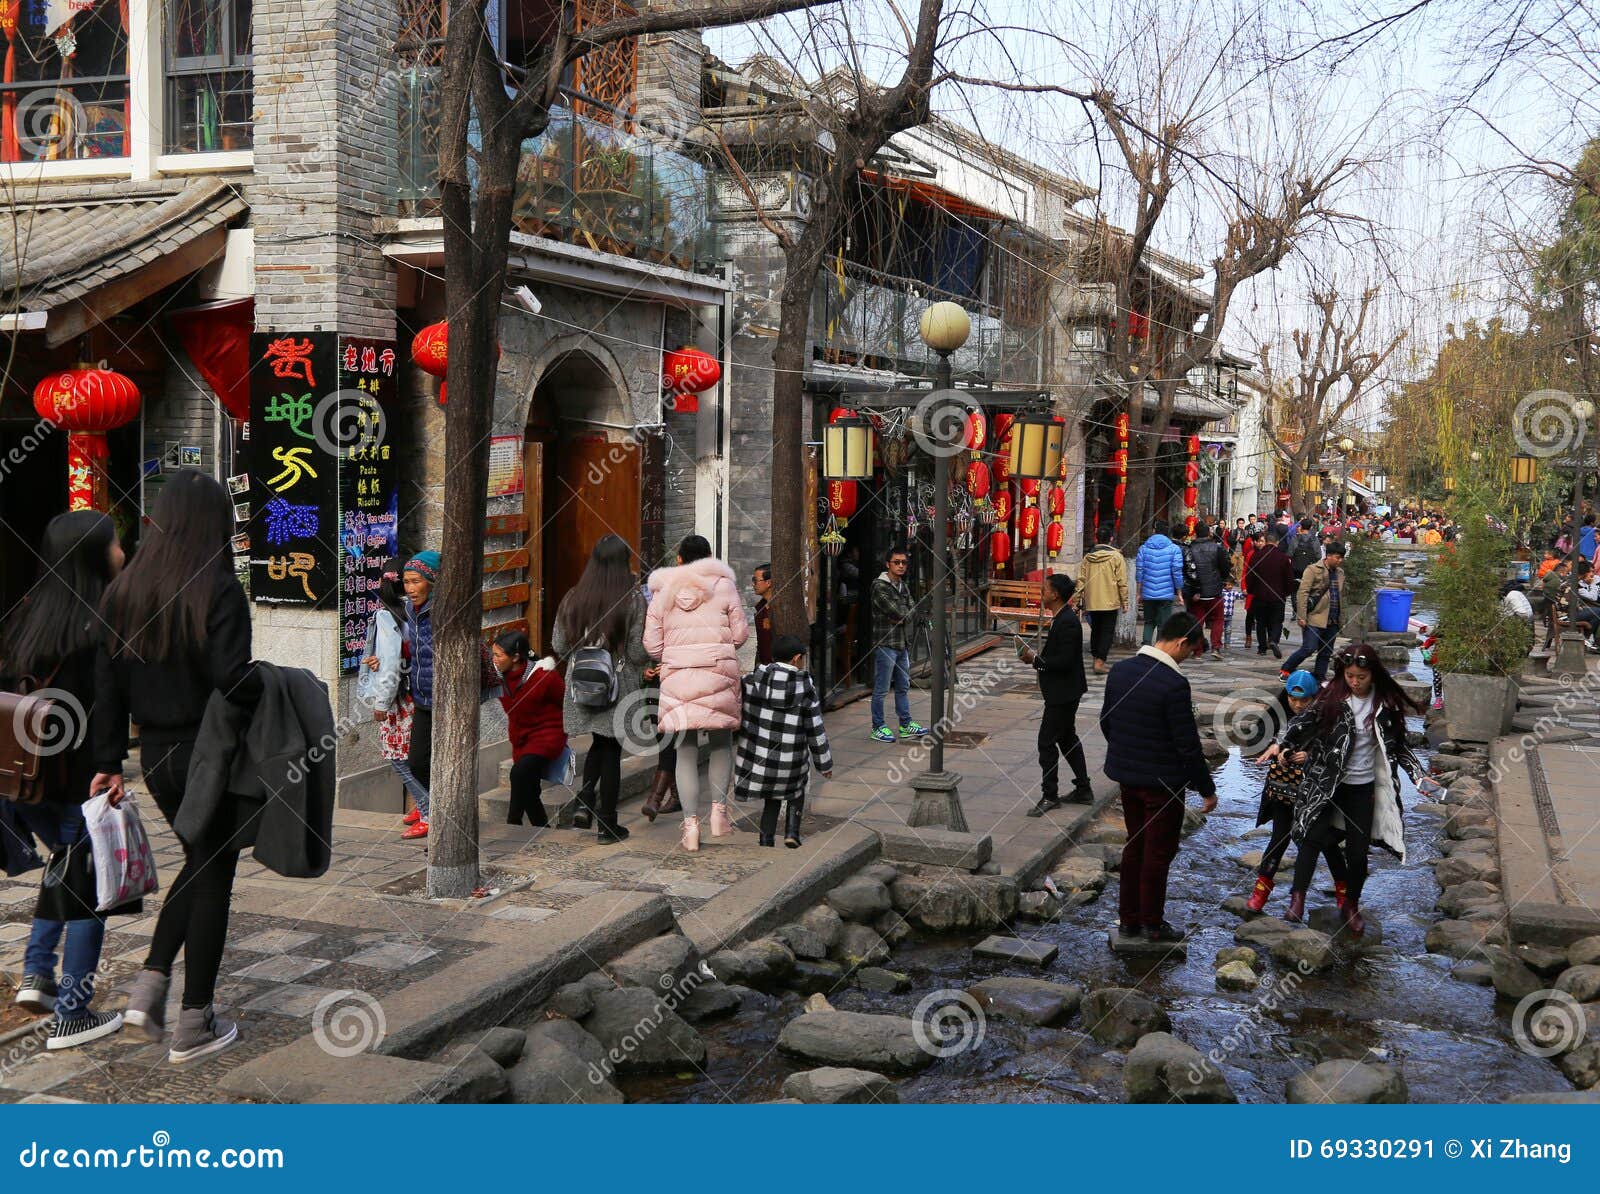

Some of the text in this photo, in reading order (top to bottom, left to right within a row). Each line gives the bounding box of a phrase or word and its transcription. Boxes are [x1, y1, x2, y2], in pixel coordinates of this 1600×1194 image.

[343, 344, 395, 377] 老地方
[357, 377, 380, 395] 牛排
[348, 444, 391, 461] 意大利面
[359, 465, 377, 475] Pasta
[344, 576, 366, 596] 啤酒
[344, 597, 366, 617] 红酒
